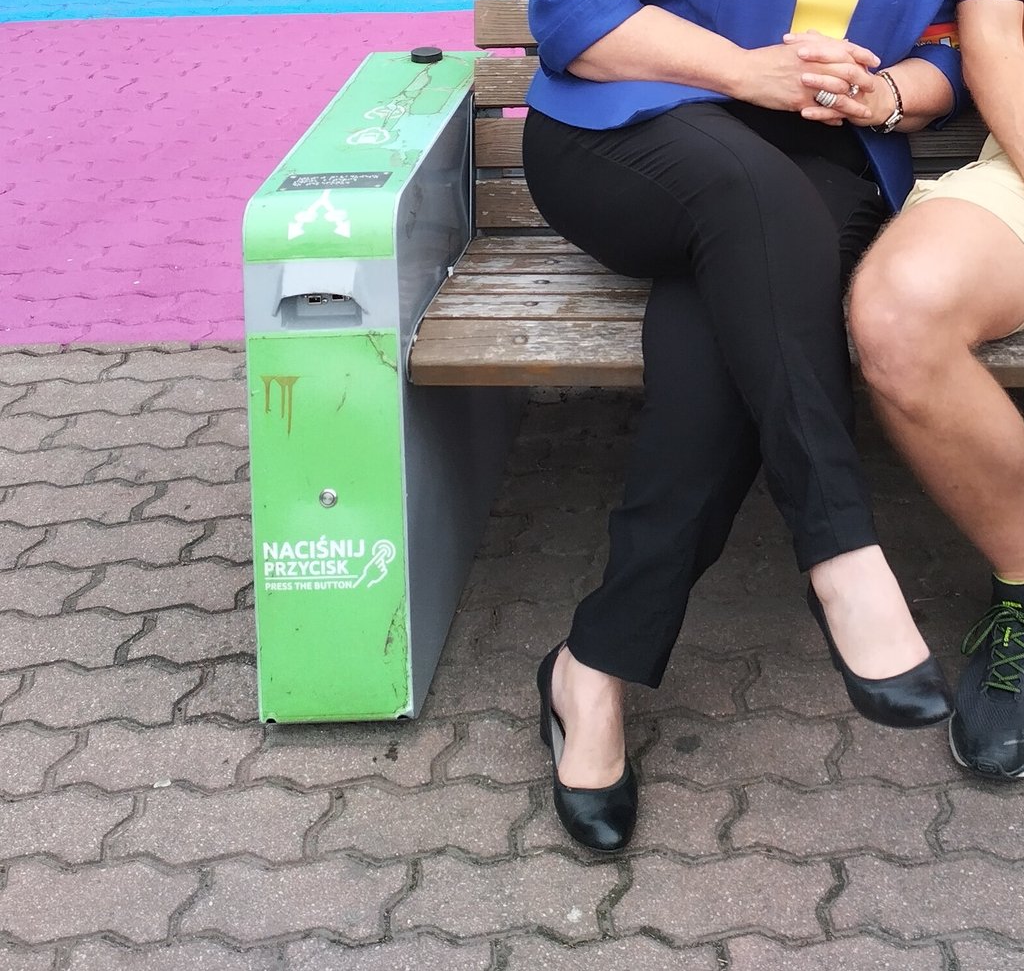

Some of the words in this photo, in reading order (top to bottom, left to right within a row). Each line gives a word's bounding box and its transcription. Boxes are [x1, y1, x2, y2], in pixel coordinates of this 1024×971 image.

[262, 535, 365, 560] NACIŚNIJ
[263, 560, 350, 576] PRZYCISK
[265, 581, 293, 591] PRESS
[294, 581, 313, 590] THE
[314, 580, 353, 590] BUTTON
